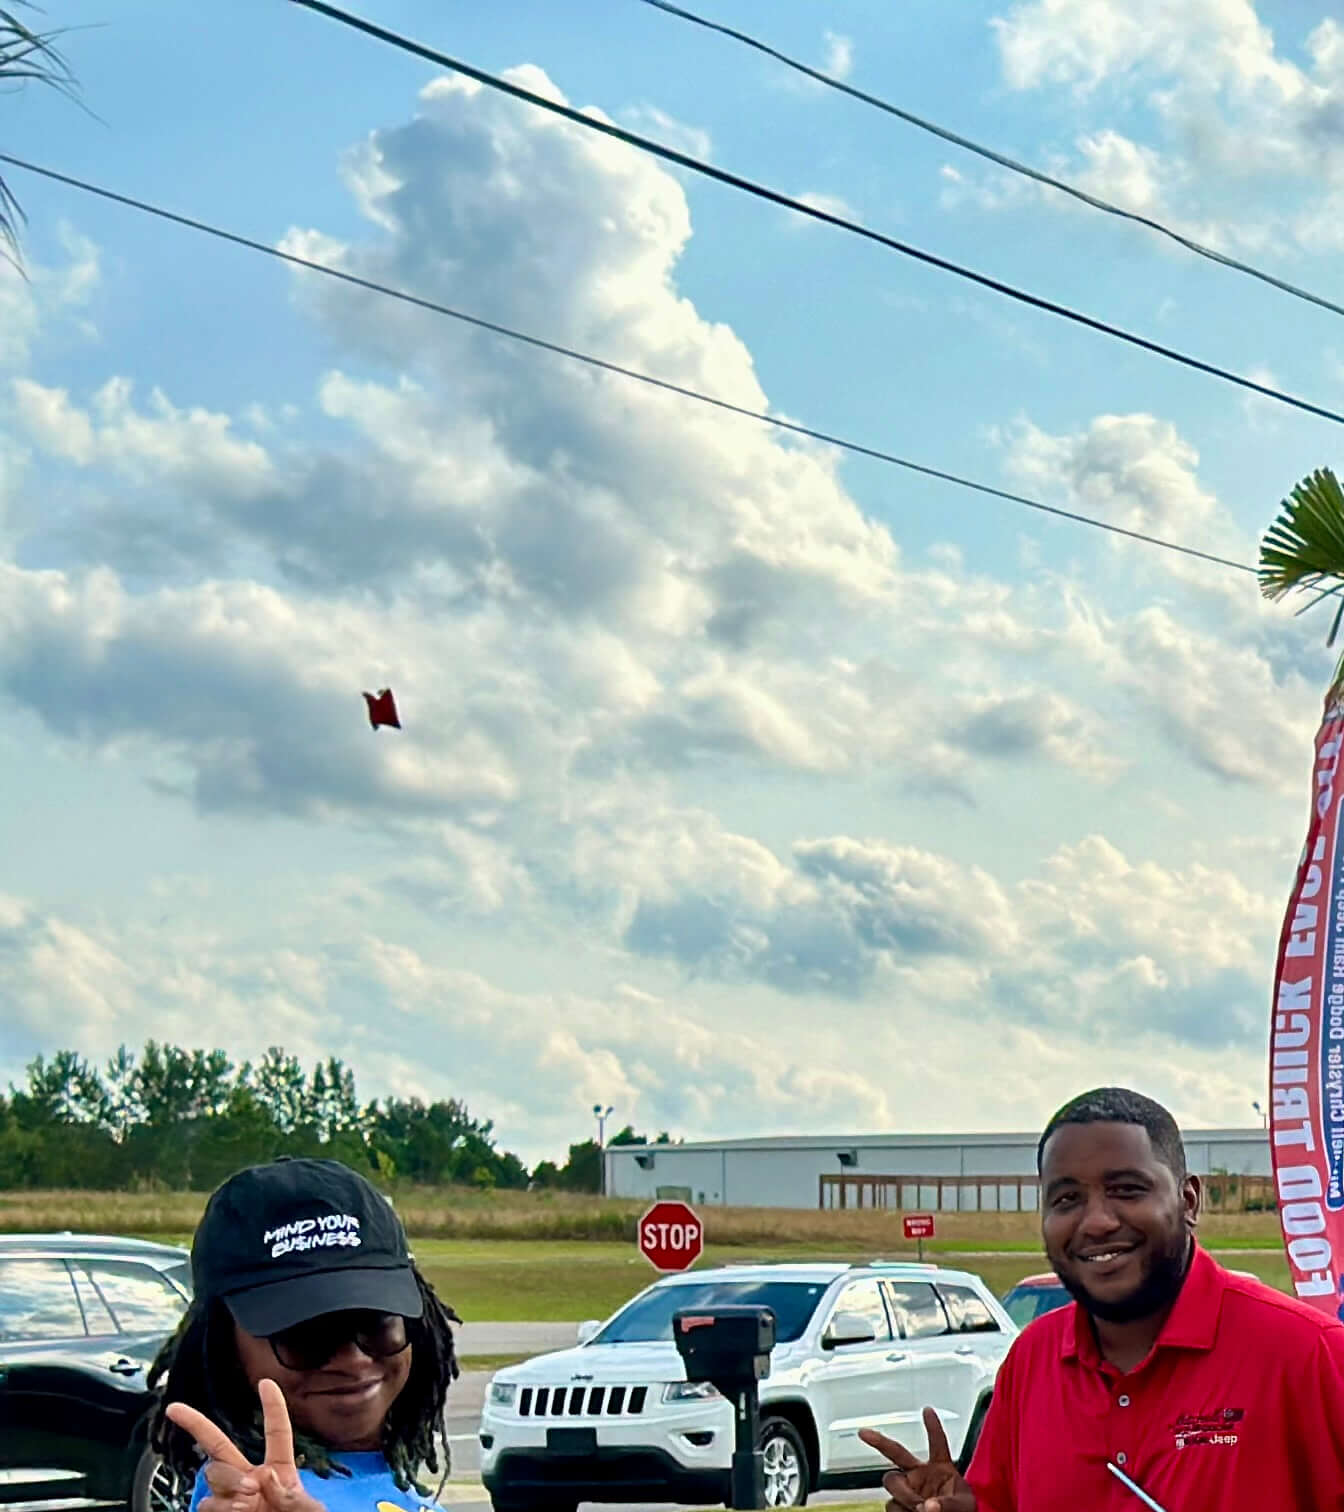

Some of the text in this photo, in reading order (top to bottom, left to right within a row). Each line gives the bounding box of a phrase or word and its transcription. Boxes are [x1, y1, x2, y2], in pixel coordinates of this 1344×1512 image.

[263, 1214, 360, 1244] MIND YOUR
[643, 1223, 699, 1250] STOP
